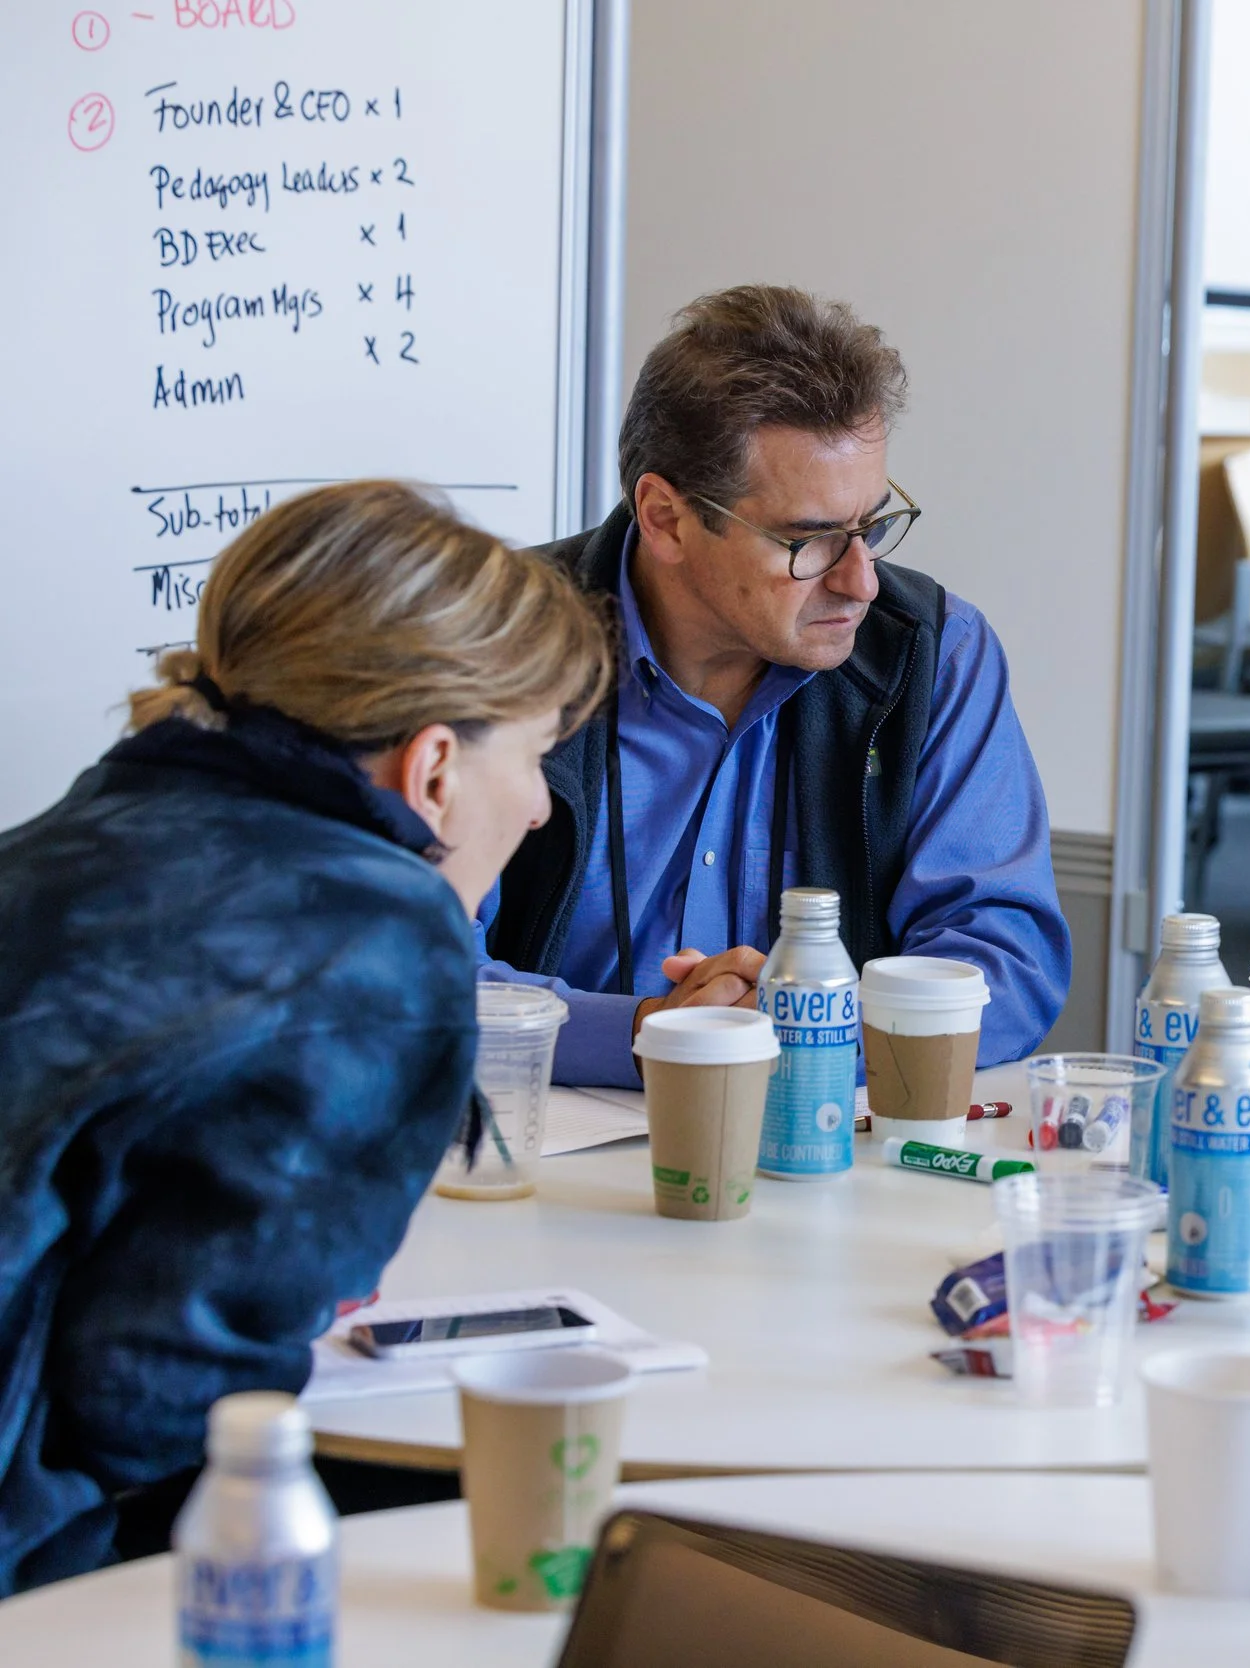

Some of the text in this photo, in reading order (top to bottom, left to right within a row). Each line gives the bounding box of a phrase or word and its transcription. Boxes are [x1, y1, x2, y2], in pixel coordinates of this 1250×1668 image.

[144, 82, 265, 132] Founder
[274, 80, 295, 119] &
[149, 164, 270, 213] Pedagogy
[392, 156, 416, 186] 2
[397, 211, 407, 241] 1
[151, 287, 265, 349] Program
[395, 273, 416, 311] 4
[398, 330, 420, 365] 2
[153, 364, 246, 409] Admin
[774, 990, 837, 1022] ever
[842, 990, 855, 1020] &
[1139, 1008, 1199, 1043] & ev
[1202, 1092, 1225, 1128] &
